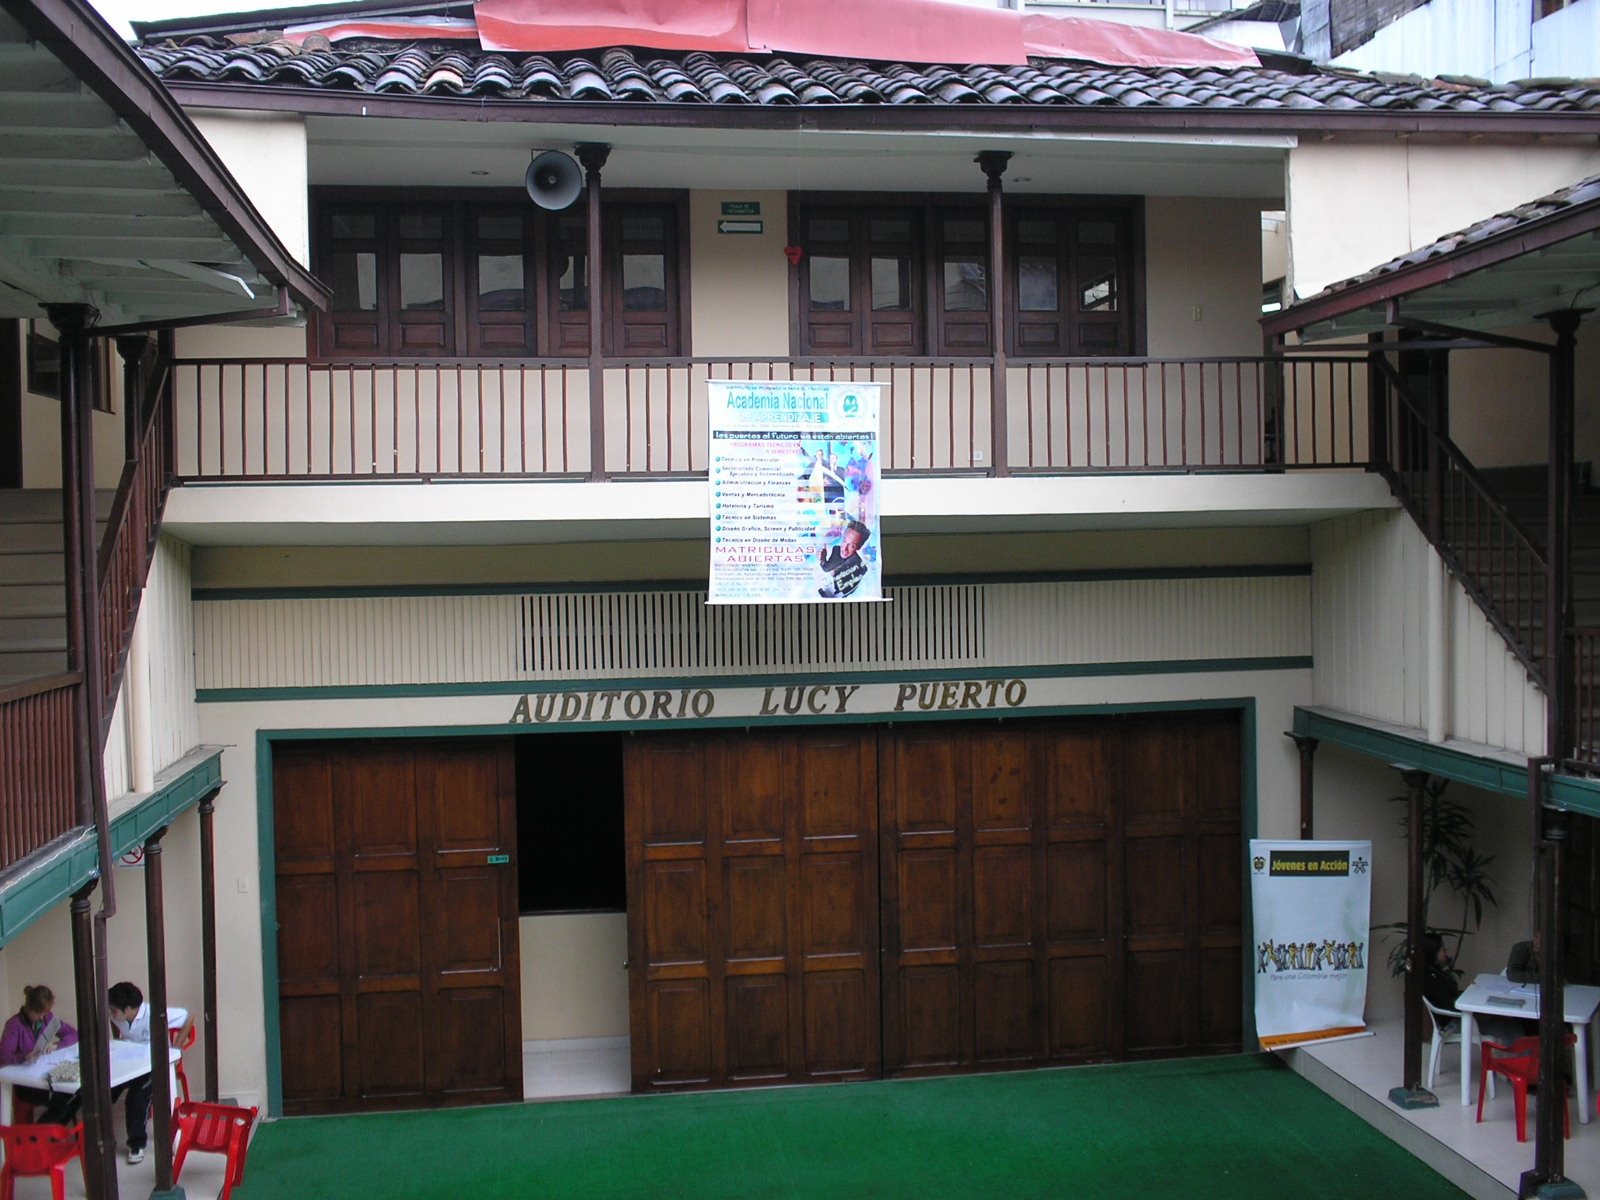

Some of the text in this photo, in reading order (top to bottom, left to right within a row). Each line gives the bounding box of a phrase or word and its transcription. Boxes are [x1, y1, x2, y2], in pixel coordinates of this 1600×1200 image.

[726, 391, 780, 409] Academia
[783, 391, 829, 410] Nacional
[739, 412, 822, 423] DE APRENDIZAJE
[762, 432, 771, 440] al
[771, 432, 799, 440] Futuro
[715, 546, 815, 554] MATRICULAS
[727, 555, 804, 563] ABIERTAS
[508, 679, 1028, 724] AUDITORIO LUCY PUERTO
[1271, 860, 1305, 871] Jóvenes
[1308, 861, 1319, 871] en
[1320, 859, 1348, 871] Acción
